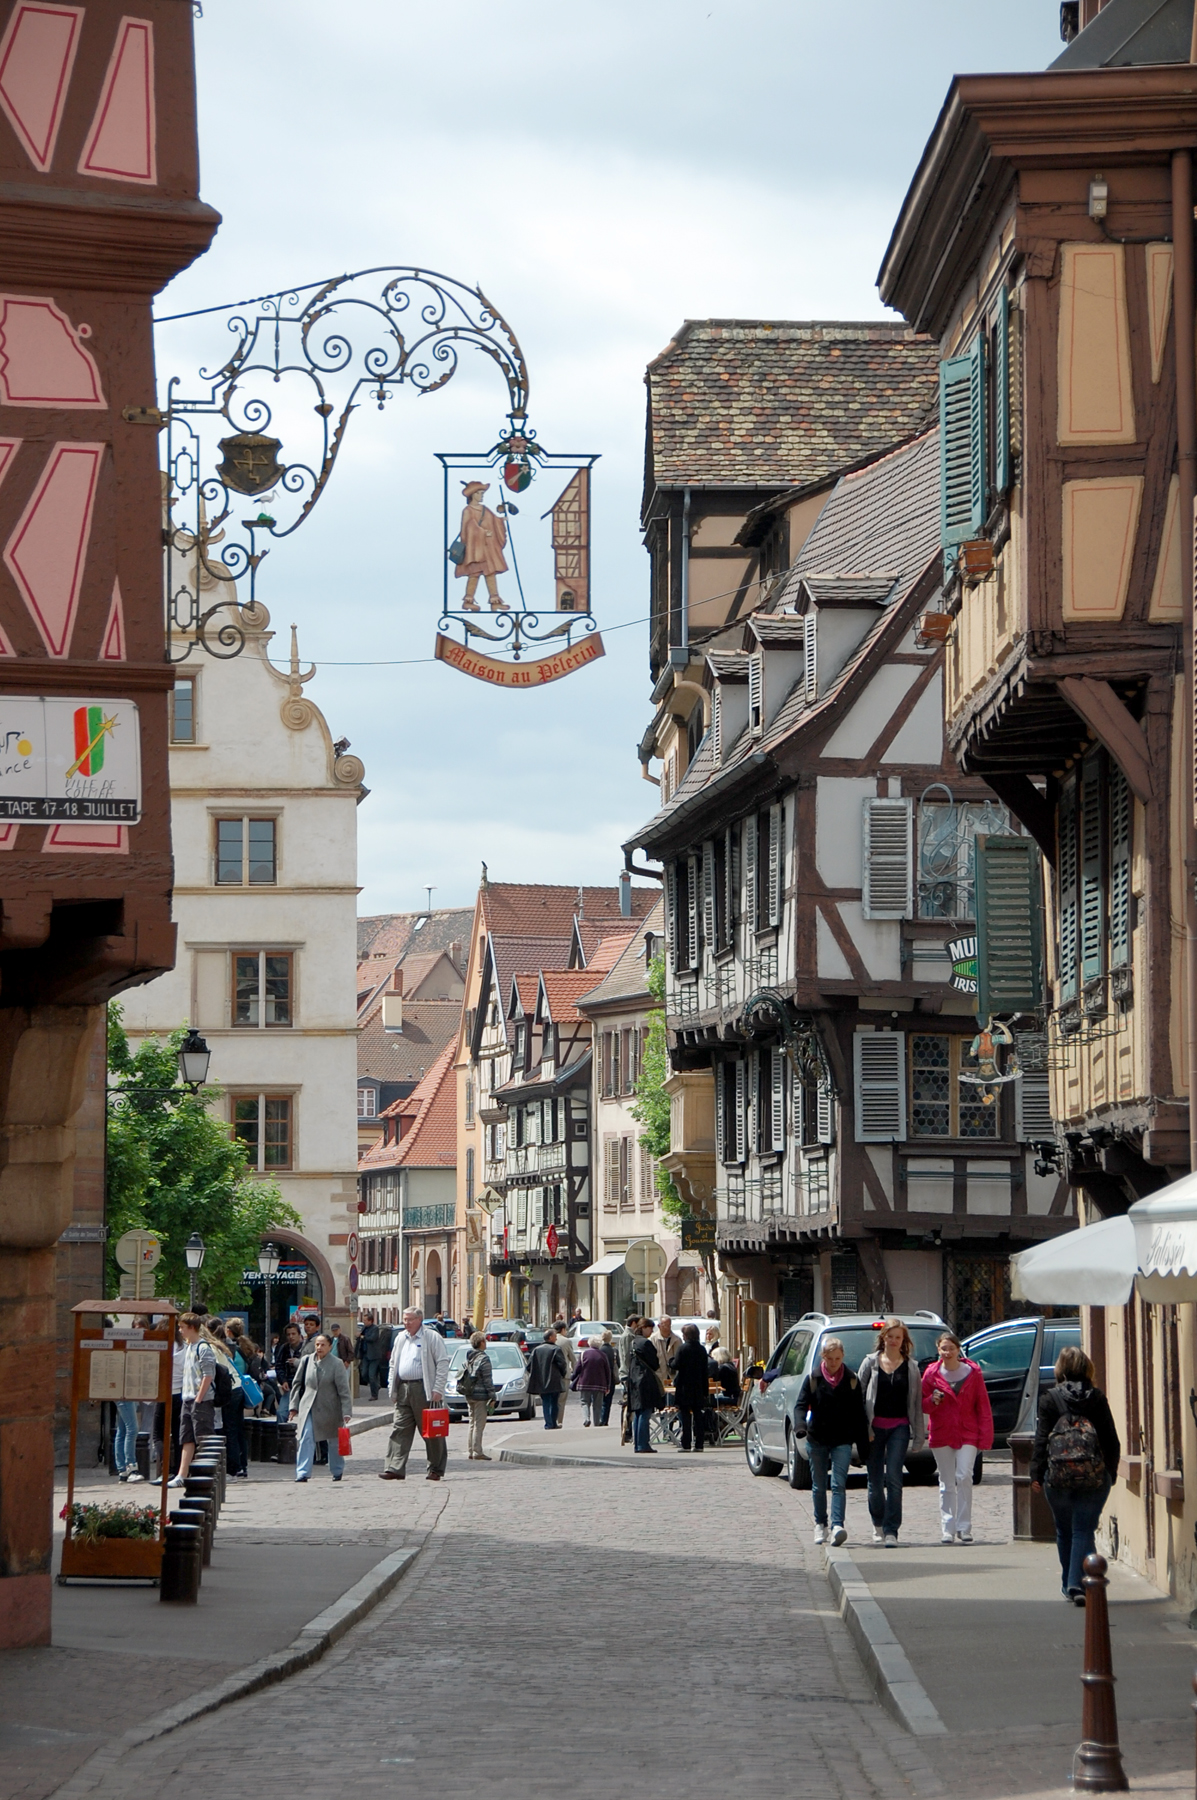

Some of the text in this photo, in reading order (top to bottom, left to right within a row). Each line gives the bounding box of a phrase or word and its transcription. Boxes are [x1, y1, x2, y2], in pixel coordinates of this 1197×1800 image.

[445, 645, 597, 683] Maison au Pélerin
[65, 779, 117, 789] VILLE DE
[65, 787, 114, 798] COLMAR
[42, 802, 78, 816] 17-18
[83, 803, 136, 817] JUILLET
[953, 977, 979, 993] IRIS
